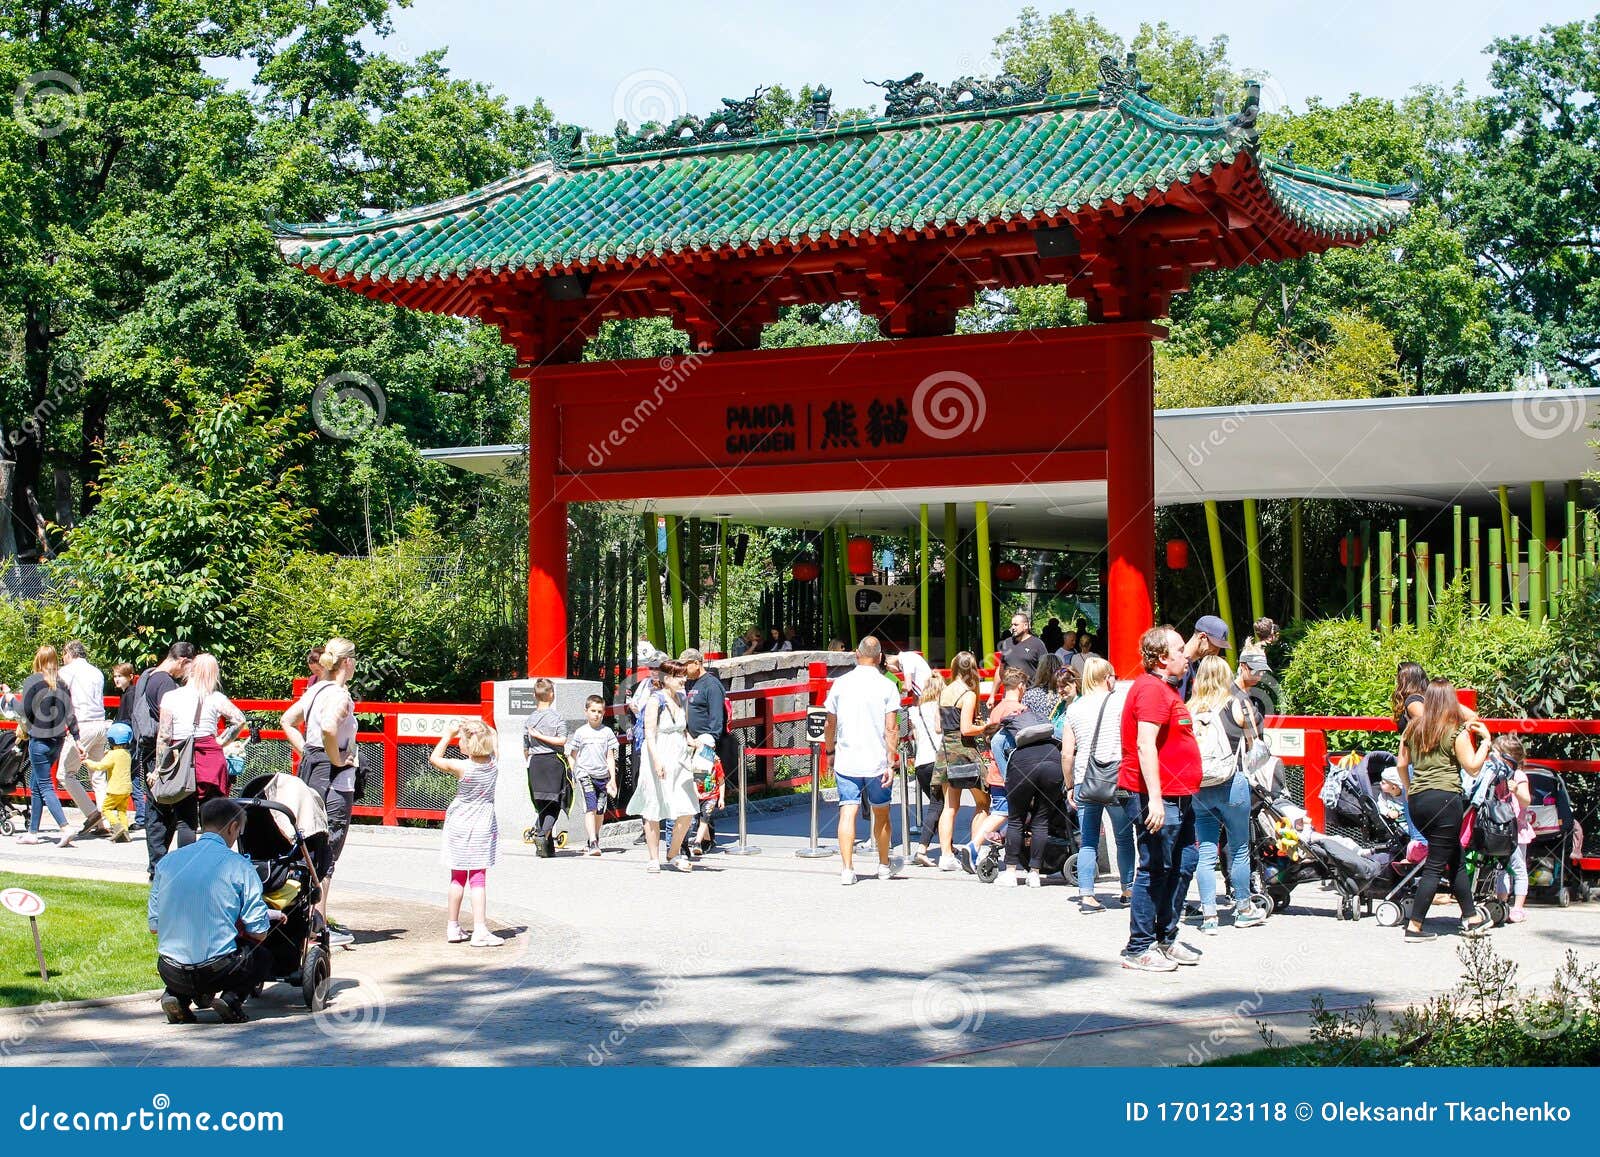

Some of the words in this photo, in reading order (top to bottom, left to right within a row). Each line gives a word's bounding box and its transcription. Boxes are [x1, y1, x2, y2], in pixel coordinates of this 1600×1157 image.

[726, 403, 794, 429] PANDA
[820, 398, 908, 449] 熊貓
[726, 432, 795, 453] GARDEN
